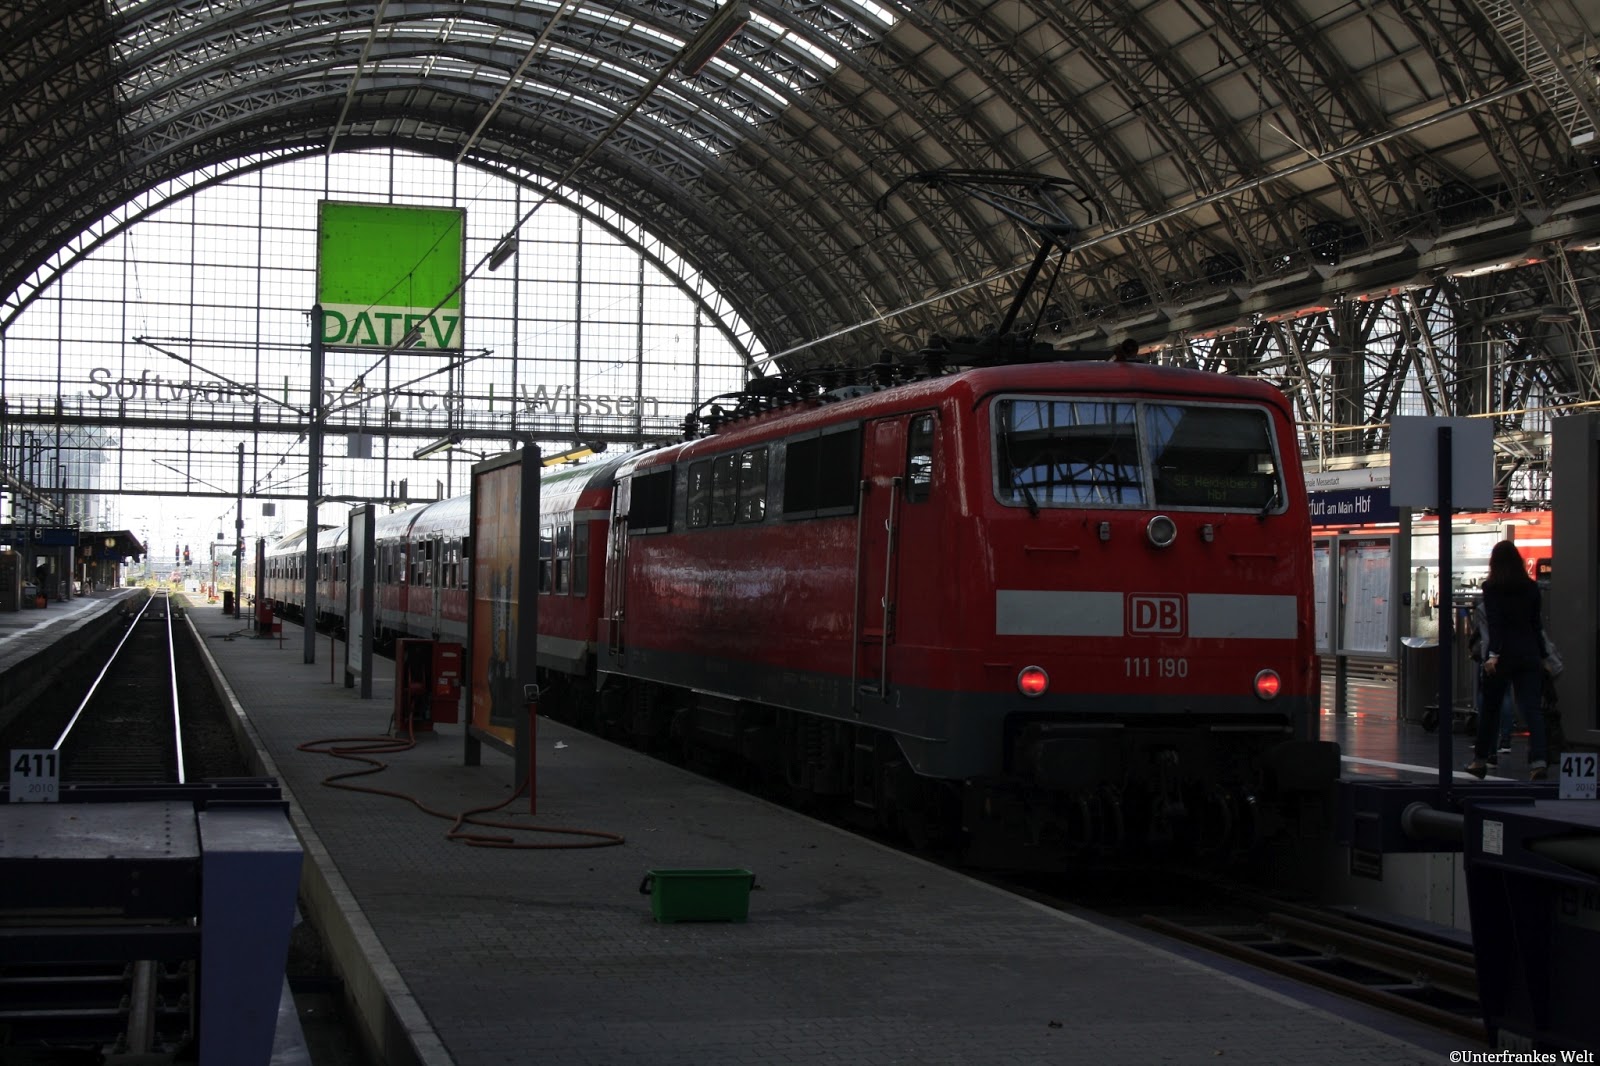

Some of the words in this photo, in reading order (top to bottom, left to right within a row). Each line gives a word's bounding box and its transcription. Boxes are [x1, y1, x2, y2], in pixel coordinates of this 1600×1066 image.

[321, 310, 458, 348] DATEV
[88, 367, 259, 404] Software
[320, 376, 463, 412] Service
[521, 383, 659, 417] Wissen
[1207, 488, 1226, 501] Hbf
[1327, 503, 1337, 515] am
[1338, 500, 1354, 514] Main
[1355, 495, 1371, 513] Hbf
[1527, 559, 1534, 575] 2
[1136, 600, 1178, 630] DB
[1124, 656, 1150, 678] 111
[1157, 656, 1188, 678] 190
[14, 754, 56, 777] 411
[1562, 756, 1595, 777] 412
[28, 783, 54, 793] 2010
